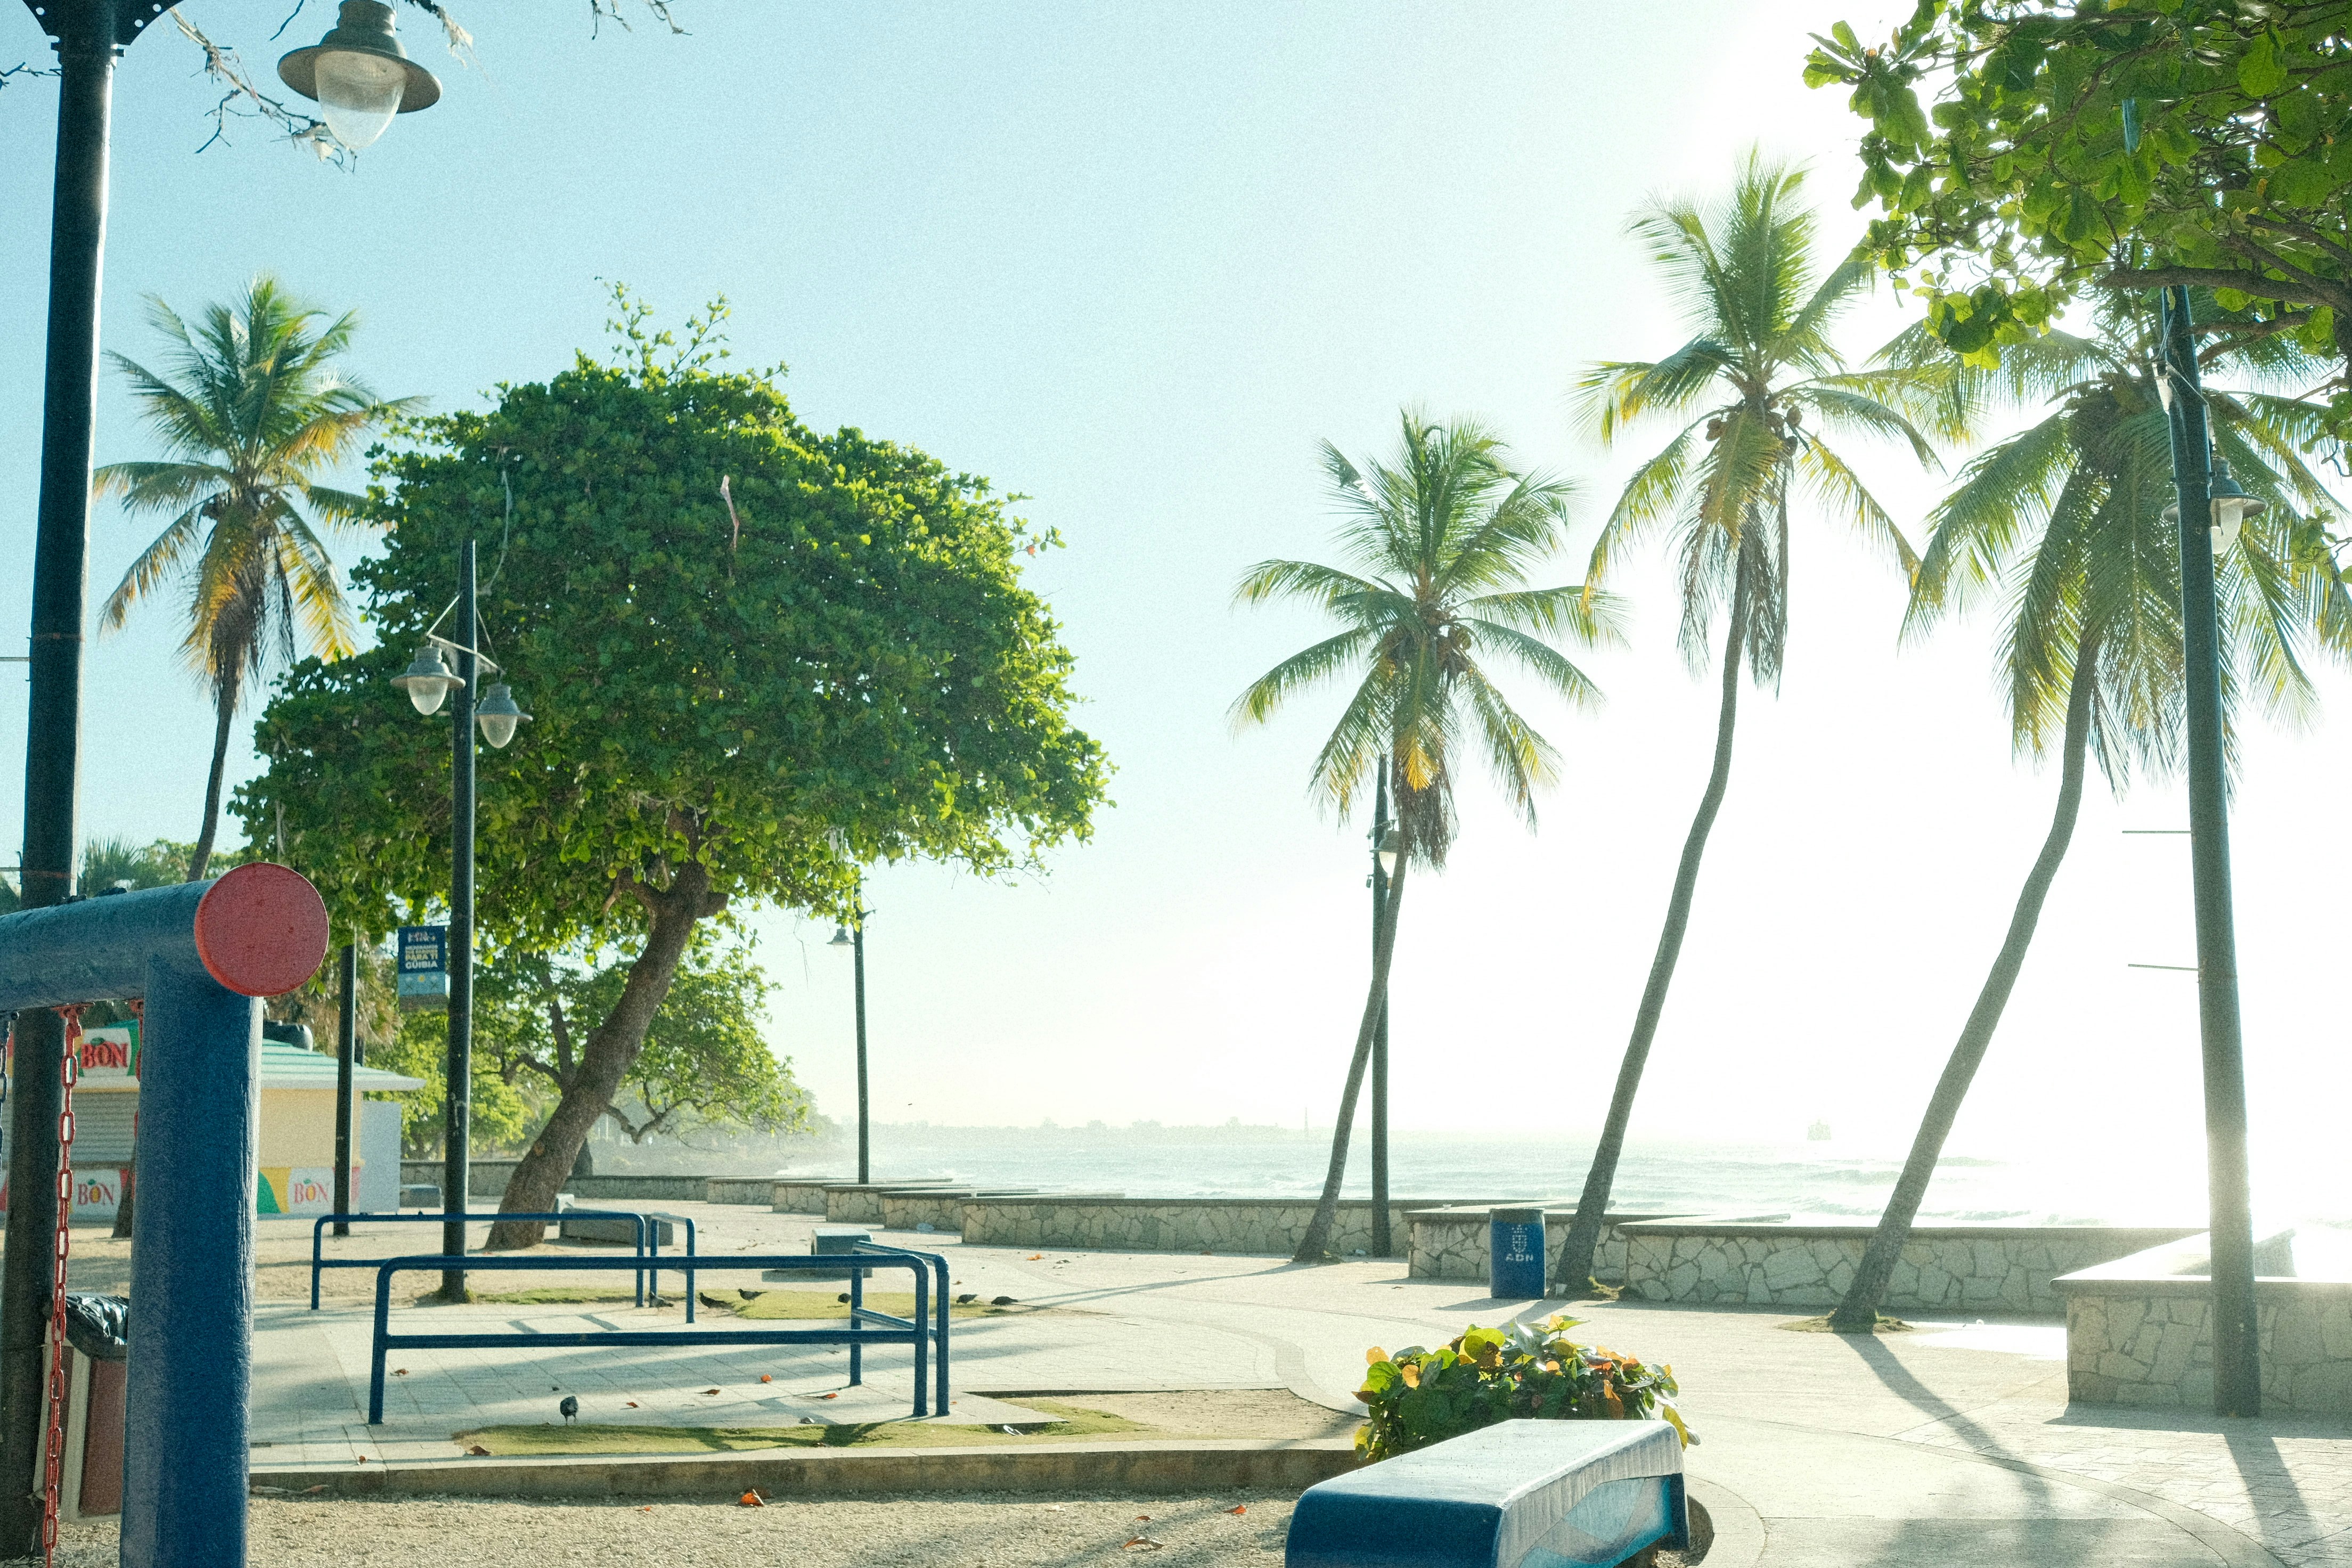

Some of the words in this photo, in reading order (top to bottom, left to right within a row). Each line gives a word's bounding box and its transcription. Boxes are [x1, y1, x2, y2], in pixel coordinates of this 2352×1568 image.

[80, 1041, 128, 1069] BON
[78, 1182, 115, 1205] BON
[294, 1182, 330, 1204] BON
[1505, 1253, 1534, 1262] ADN
